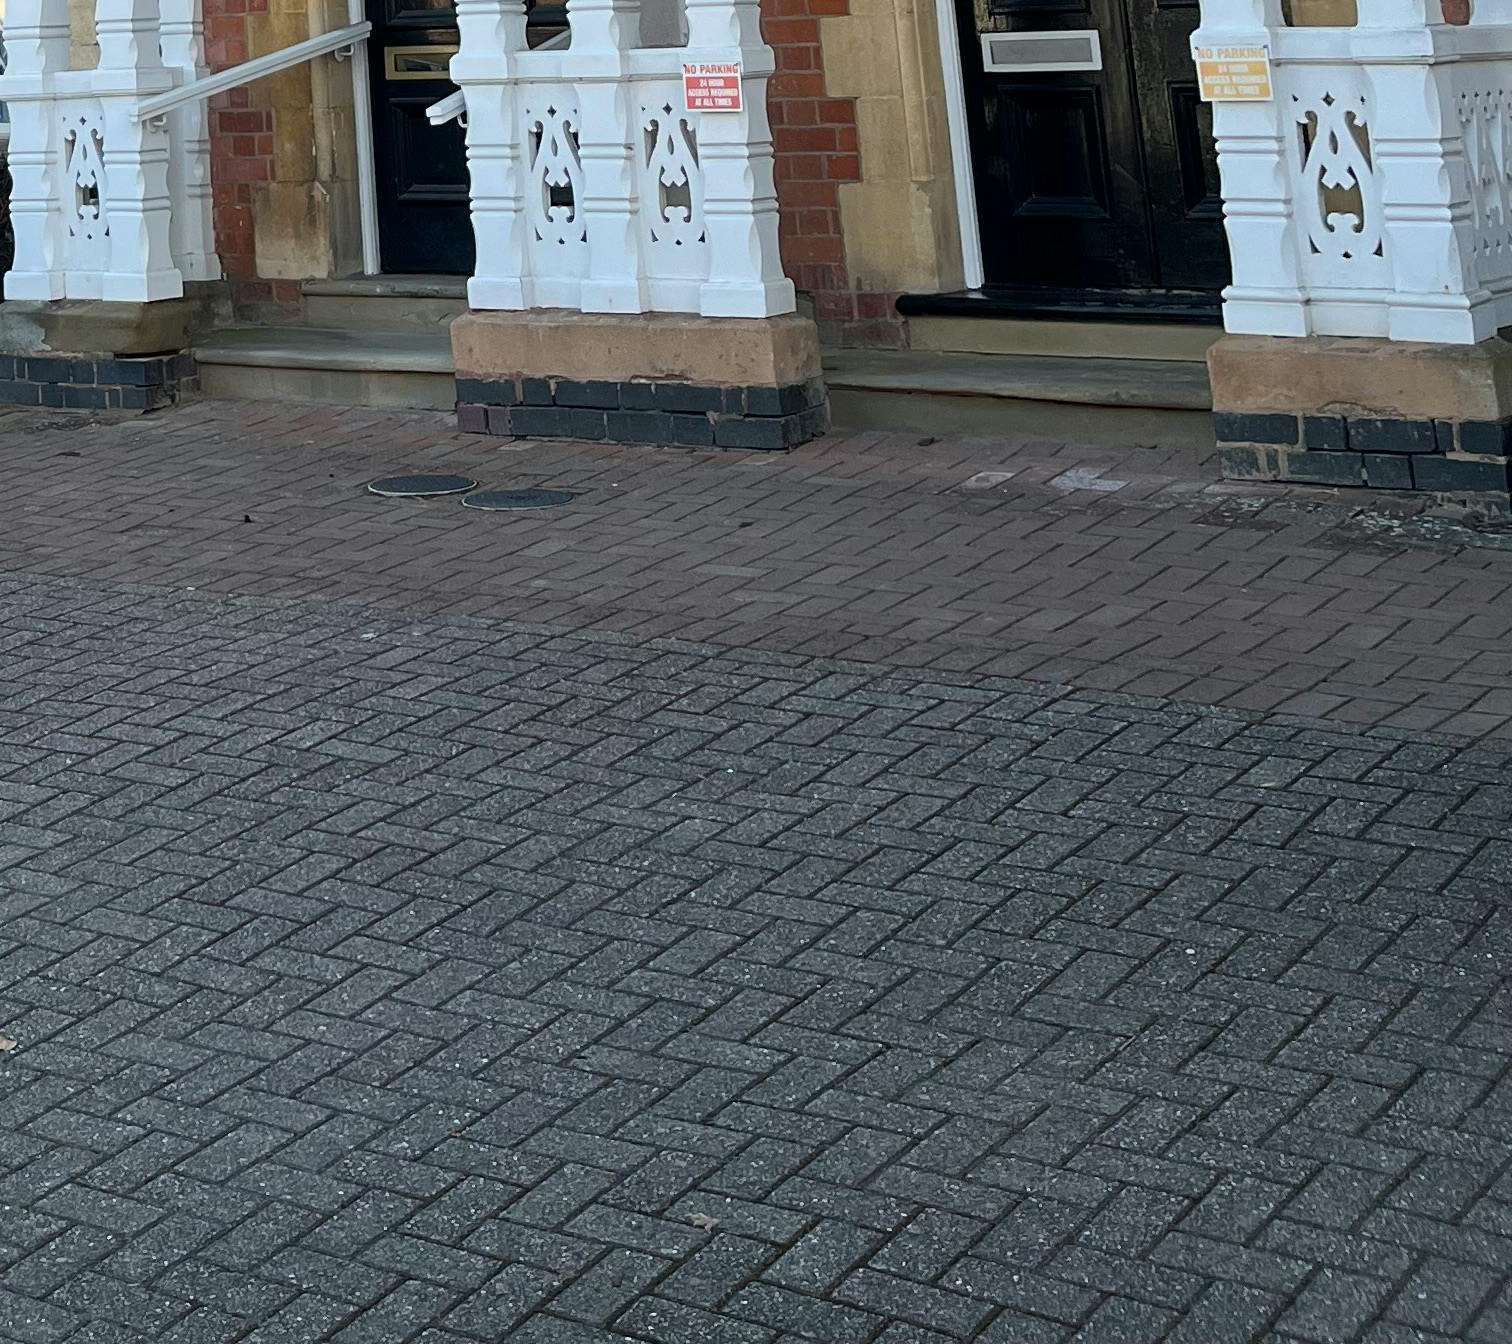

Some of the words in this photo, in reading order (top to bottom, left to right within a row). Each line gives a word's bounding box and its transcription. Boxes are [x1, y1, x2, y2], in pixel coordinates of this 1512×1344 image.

[1198, 47, 1213, 59] NO
[1217, 47, 1265, 59] PARKING
[685, 64, 696, 74] NO
[699, 63, 738, 74] PARKING
